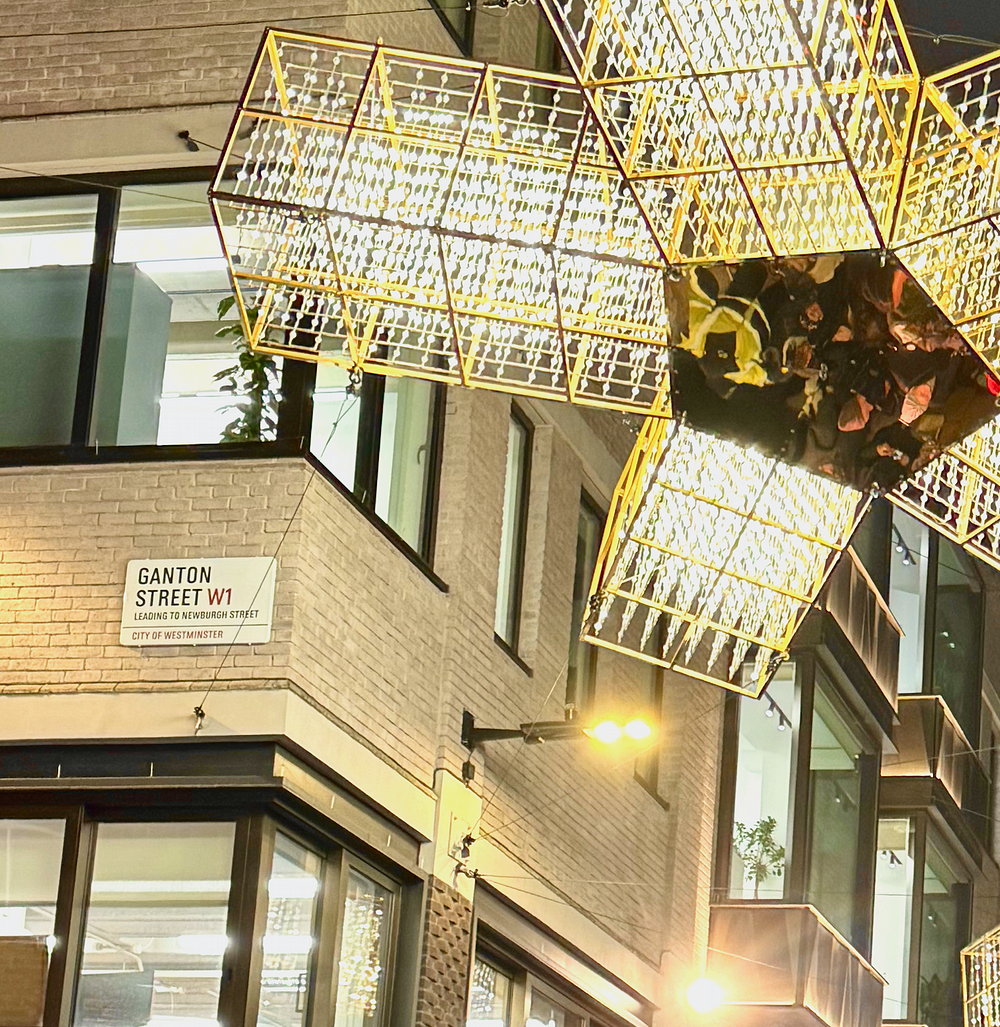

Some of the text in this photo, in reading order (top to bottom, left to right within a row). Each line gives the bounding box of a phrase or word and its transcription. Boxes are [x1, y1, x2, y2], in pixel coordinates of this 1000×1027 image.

[138, 566, 211, 585] GANTON
[135, 588, 232, 607] STREET W1
[134, 609, 259, 621] LEADING TO NEWBURGH STREET
[132, 630, 224, 640] CITY OF WESTMINSTER
